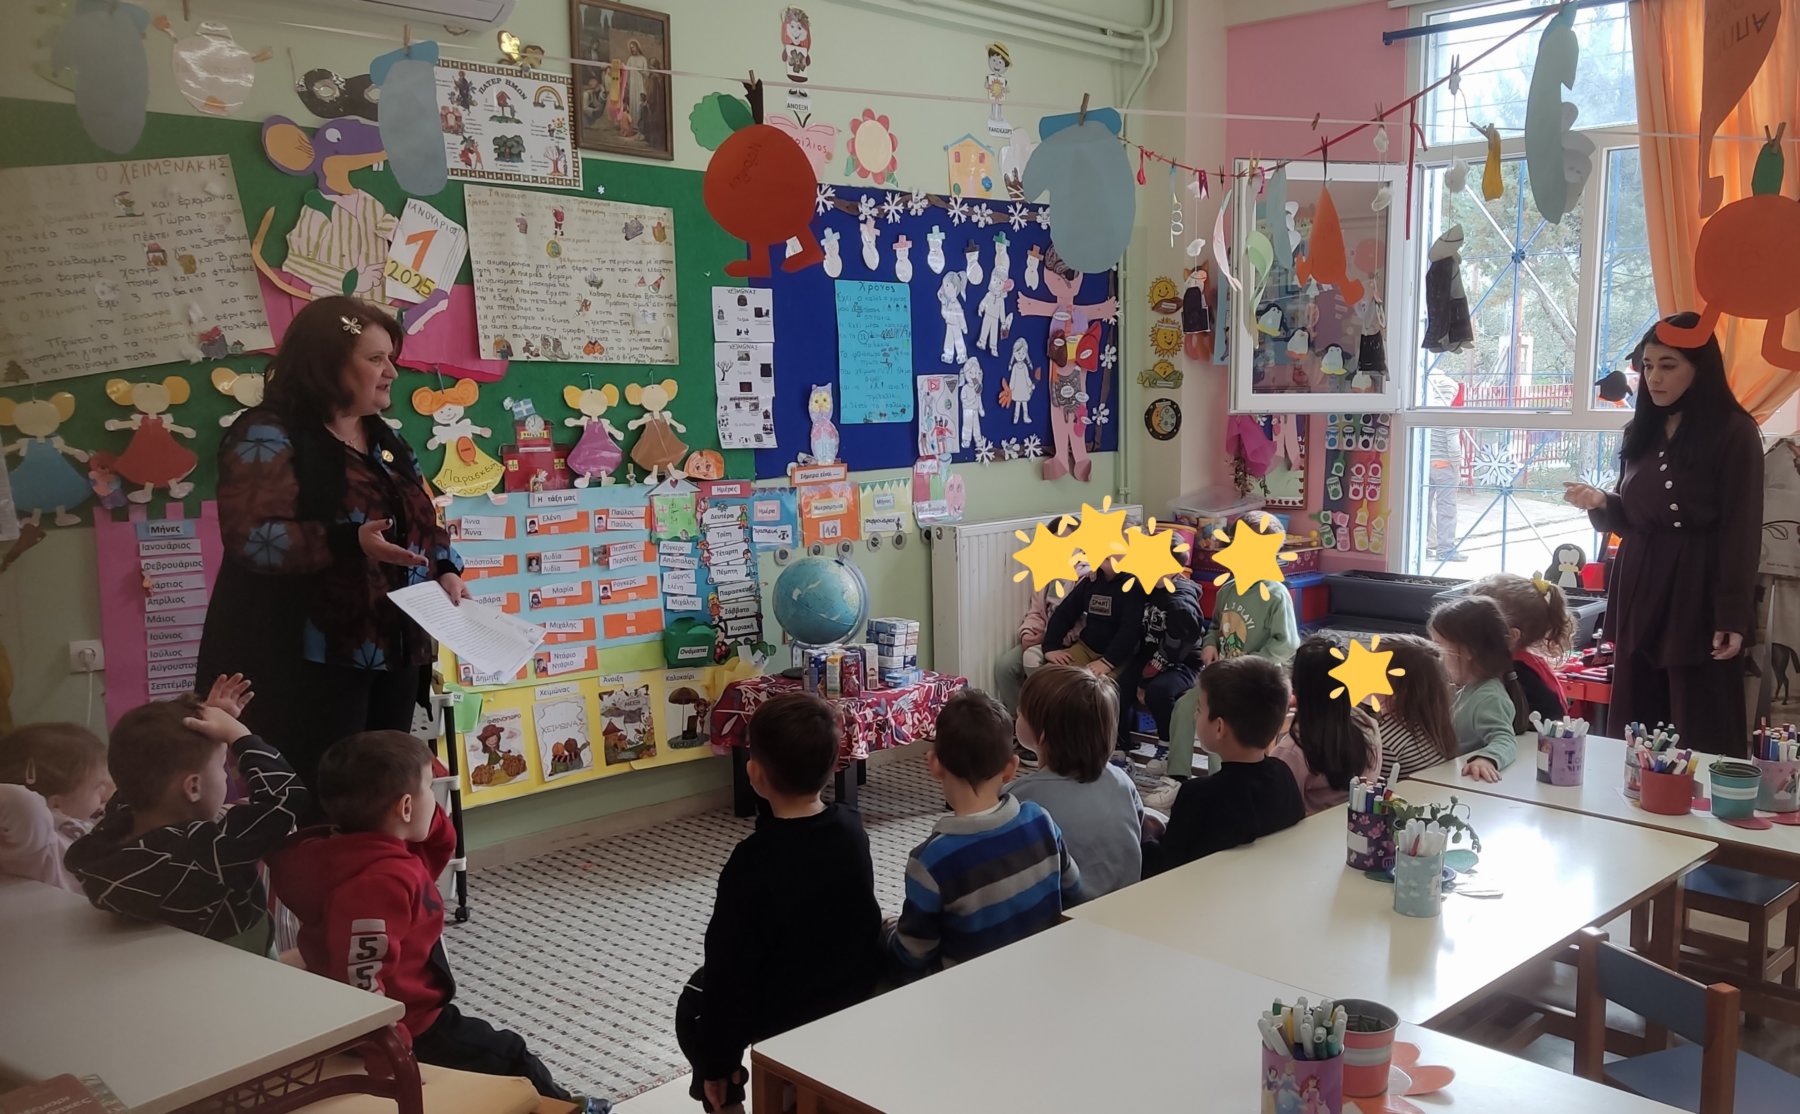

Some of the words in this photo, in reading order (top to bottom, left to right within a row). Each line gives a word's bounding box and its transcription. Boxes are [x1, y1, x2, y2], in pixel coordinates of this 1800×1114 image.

[119, 156, 230, 186] ΧΕΙΜΩΝΑΚΗΣ
[404, 228, 439, 273] 1
[386, 259, 436, 297] 2025
[716, 486, 738, 494] Ημέρες
[710, 512, 735, 520] Δευτέρα
[150, 525, 180, 535] Μήνες
[141, 541, 191, 552] Ιανουάριος
[143, 559, 203, 572] Φεβρουάριος
[465, 556, 502, 568] Απόστολος
[716, 568, 738, 577] Πέμπτη
[552, 585, 574, 595] Μαρία
[719, 585, 755, 597] Παρασκευ
[147, 594, 185, 607] Απρίλιος
[146, 613, 176, 624] Μάιος
[550, 621, 577, 629] Μιχάλης
[730, 622, 755, 633] Κυριακή
[150, 630, 183, 642] Ιούνιος
[150, 647, 183, 659] Ιούλιος
[665, 674, 695, 682] Καλοκαίρι
[539, 686, 571, 697] Χειμώνας
[356, 936, 379, 961] 5
[355, 964, 376, 991] 5
